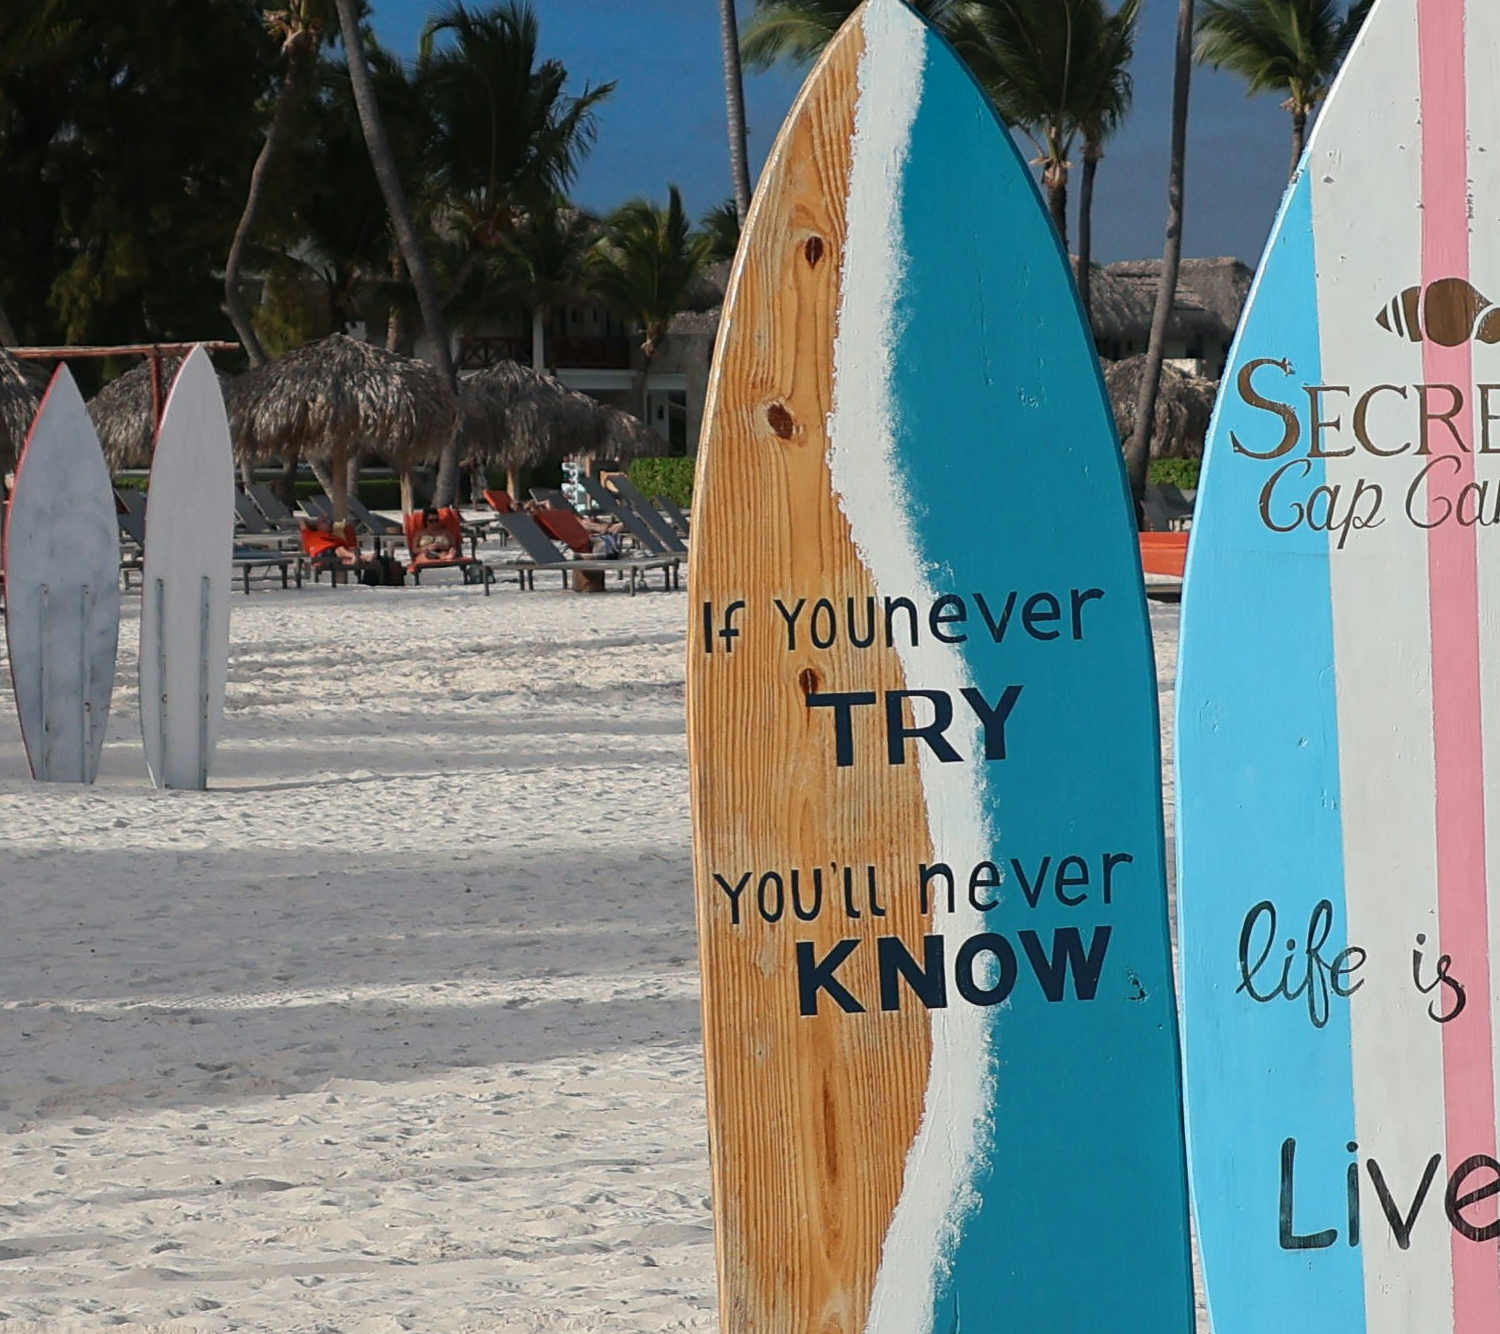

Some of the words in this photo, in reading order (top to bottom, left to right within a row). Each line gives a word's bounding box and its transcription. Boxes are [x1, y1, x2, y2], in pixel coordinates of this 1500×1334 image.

[1258, 458, 1386, 550] Cap
[702, 599, 746, 654] If
[884, 587, 1105, 648] never
[805, 684, 1024, 768] TRY
[918, 851, 1134, 915] never
[795, 925, 1113, 1017] KNOW
[1235, 899, 1367, 1029] life
[1412, 932, 1467, 1024] is
